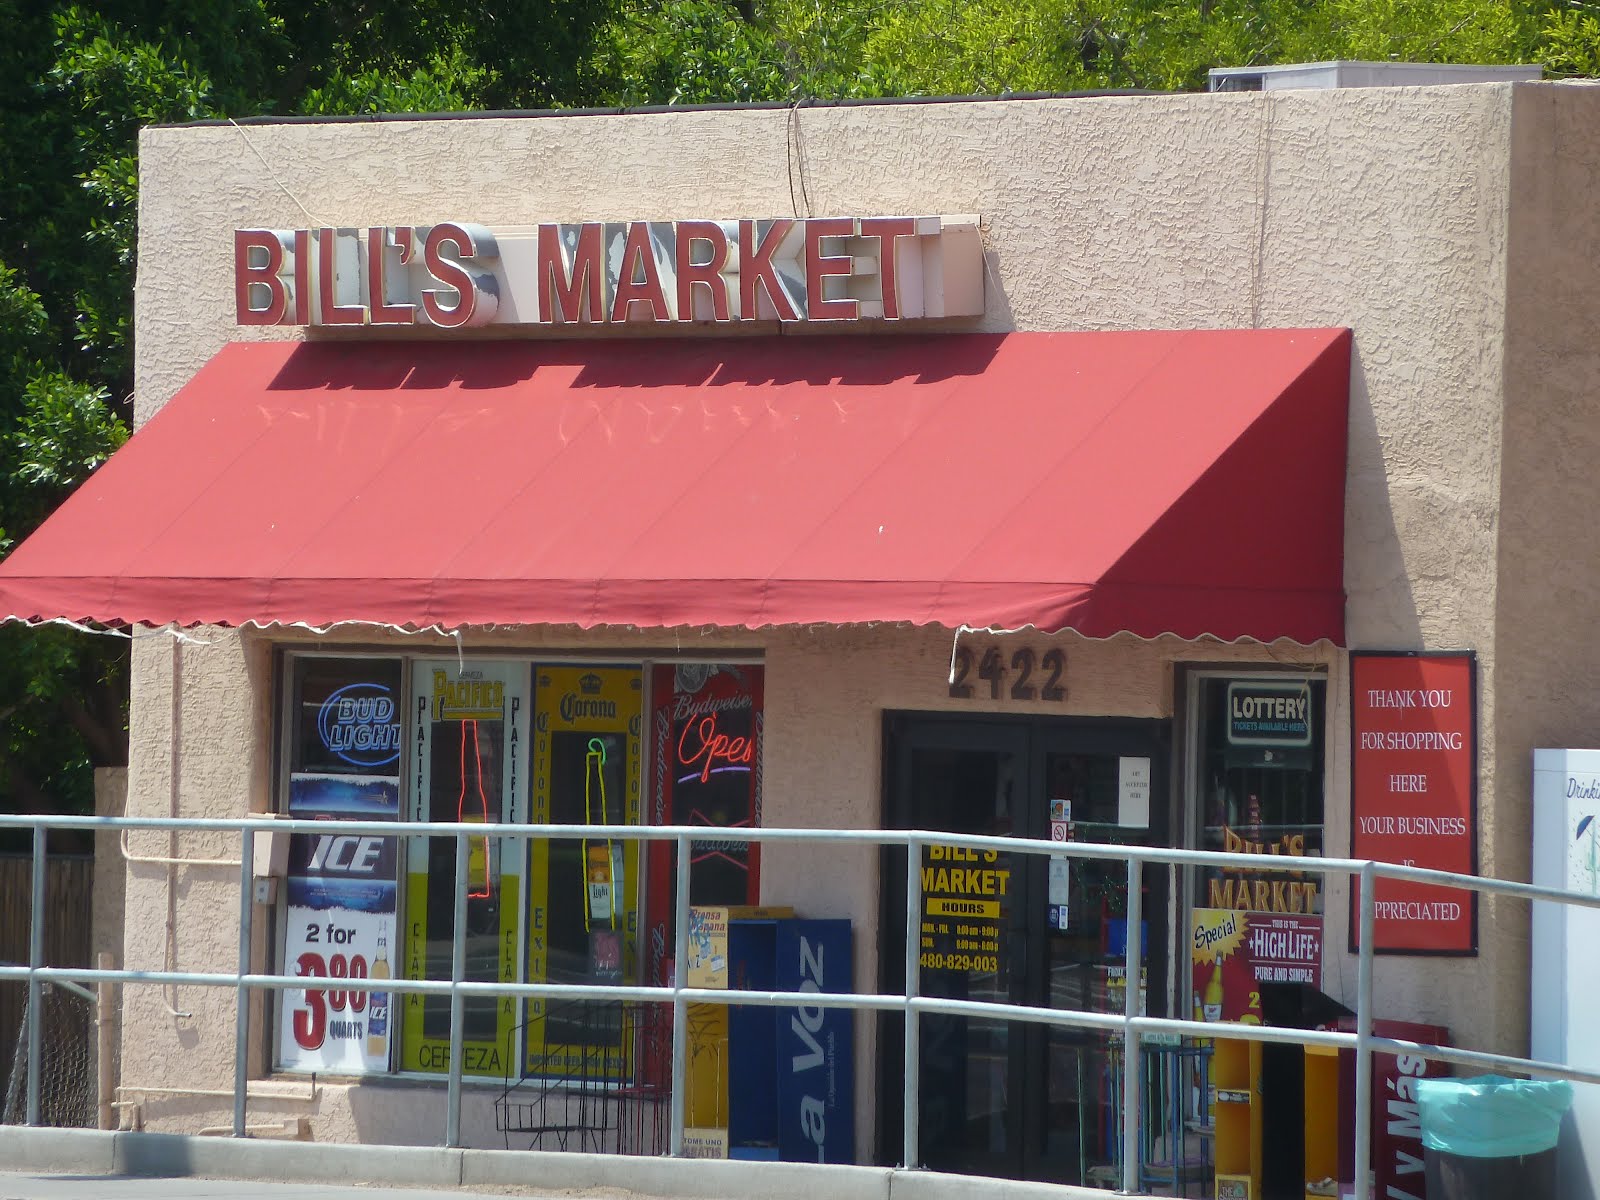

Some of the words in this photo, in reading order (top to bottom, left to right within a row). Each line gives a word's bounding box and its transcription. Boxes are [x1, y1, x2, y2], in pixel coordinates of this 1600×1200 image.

[235, 222, 480, 328] BILL'S
[538, 216, 917, 323] MARKET
[950, 646, 1068, 701] 2422
[432, 669, 504, 720] PACIFICO
[673, 691, 752, 721] Budweise
[1368, 689, 1416, 708] THANK
[1419, 690, 1452, 708] YOU
[338, 697, 394, 724] BUD
[560, 692, 616, 724] Corona
[1233, 696, 1306, 719] LOTTERY
[330, 725, 400, 751] LIGHT
[1234, 721, 1257, 731] TICKETS
[1259, 722, 1288, 731] AVAILABLE
[1289, 723, 1305, 731] HERE
[1361, 732, 1385, 750] FOR
[1387, 732, 1462, 750] SHOPPING
[416, 696, 426, 838] PACIFIC
[509, 697, 519, 838] PACIFIC
[1389, 774, 1427, 793] HERE
[1359, 816, 1395, 835] YOUR
[1398, 817, 1466, 835] BUSINESS
[307, 835, 384, 872] ICE
[930, 845, 998, 862] BILLS
[593, 884, 608, 899] Light
[921, 867, 1010, 895] MARKET
[941, 902, 985, 914] HOURS
[1209, 879, 1317, 914] MARKET
[1374, 902, 1460, 921] PPRECIATED
[305, 923, 320, 943] 2
[326, 923, 357, 944] for
[1195, 914, 1237, 950] Special
[1272, 919, 1283, 928] THIS
[1284, 920, 1289, 928] IS
[1289, 920, 1298, 929] THE
[1255, 929, 1286, 959] HIGH
[1288, 930, 1314, 960] LIFE
[504, 930, 513, 1015] CLAA
[533, 908, 544, 1015] Exta
[1254, 966, 1272, 981] PURE
[1274, 967, 1288, 982] AND
[1288, 968, 1313, 983] SIMPLE
[791, 935, 825, 1073] Voz
[1249, 992, 1260, 1008] 2
[369, 1006, 387, 1019] ICE
[329, 1020, 363, 1040] QUARTS
[705, 1138, 722, 1146] UNO
